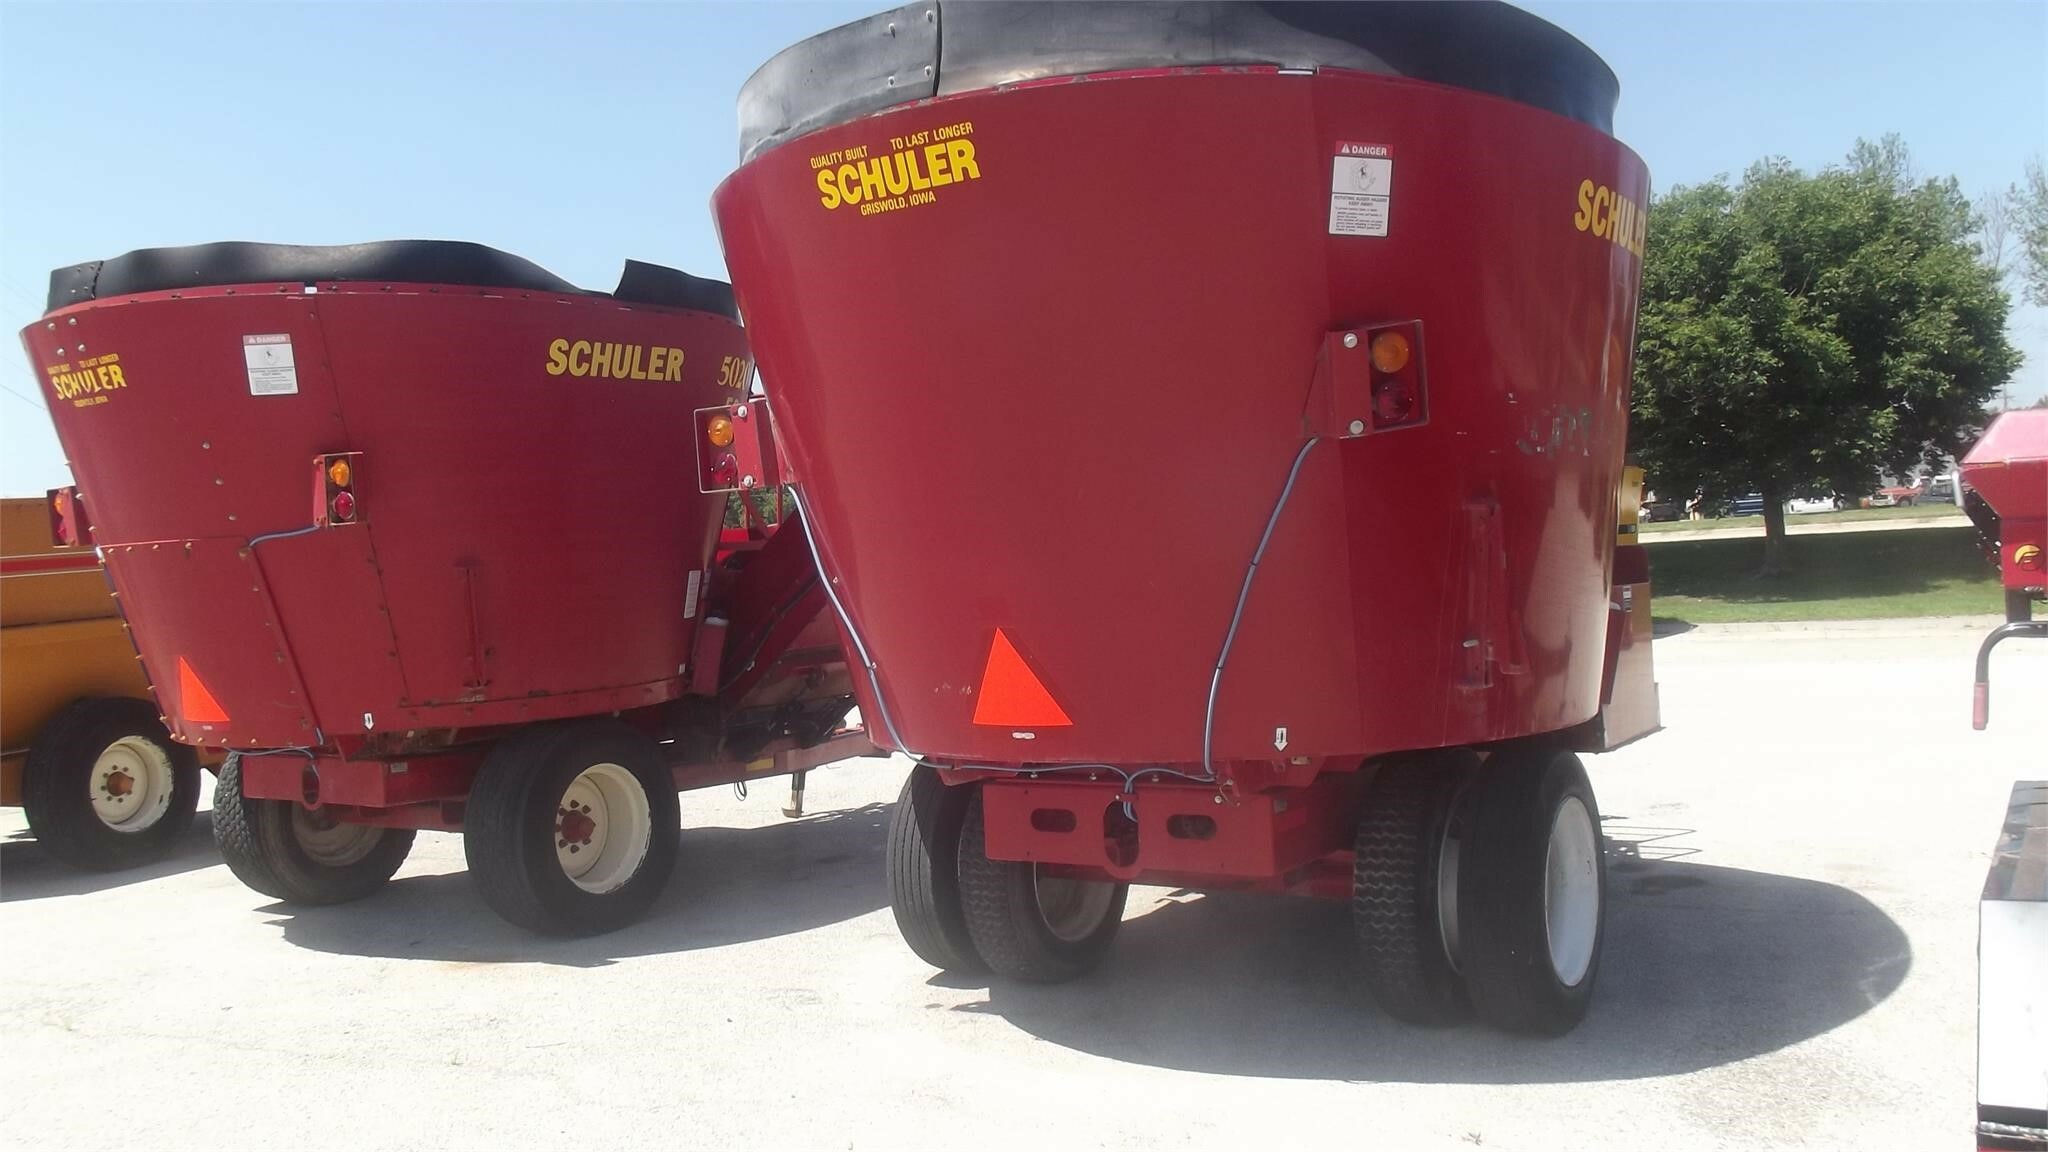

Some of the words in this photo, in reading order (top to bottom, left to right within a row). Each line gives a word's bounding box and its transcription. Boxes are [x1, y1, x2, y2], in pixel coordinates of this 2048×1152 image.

[889, 138, 903, 151] TO
[906, 131, 929, 148] LAST
[933, 121, 974, 141] LONGER
[1351, 145, 1387, 156] DANGER
[810, 150, 843, 169] QUALITY
[845, 145, 869, 162] BUILT
[817, 138, 981, 210] SCHULER
[909, 191, 936, 206] IOWA
[545, 338, 685, 382] SCHULER
[52, 363, 127, 400] SCHULER
